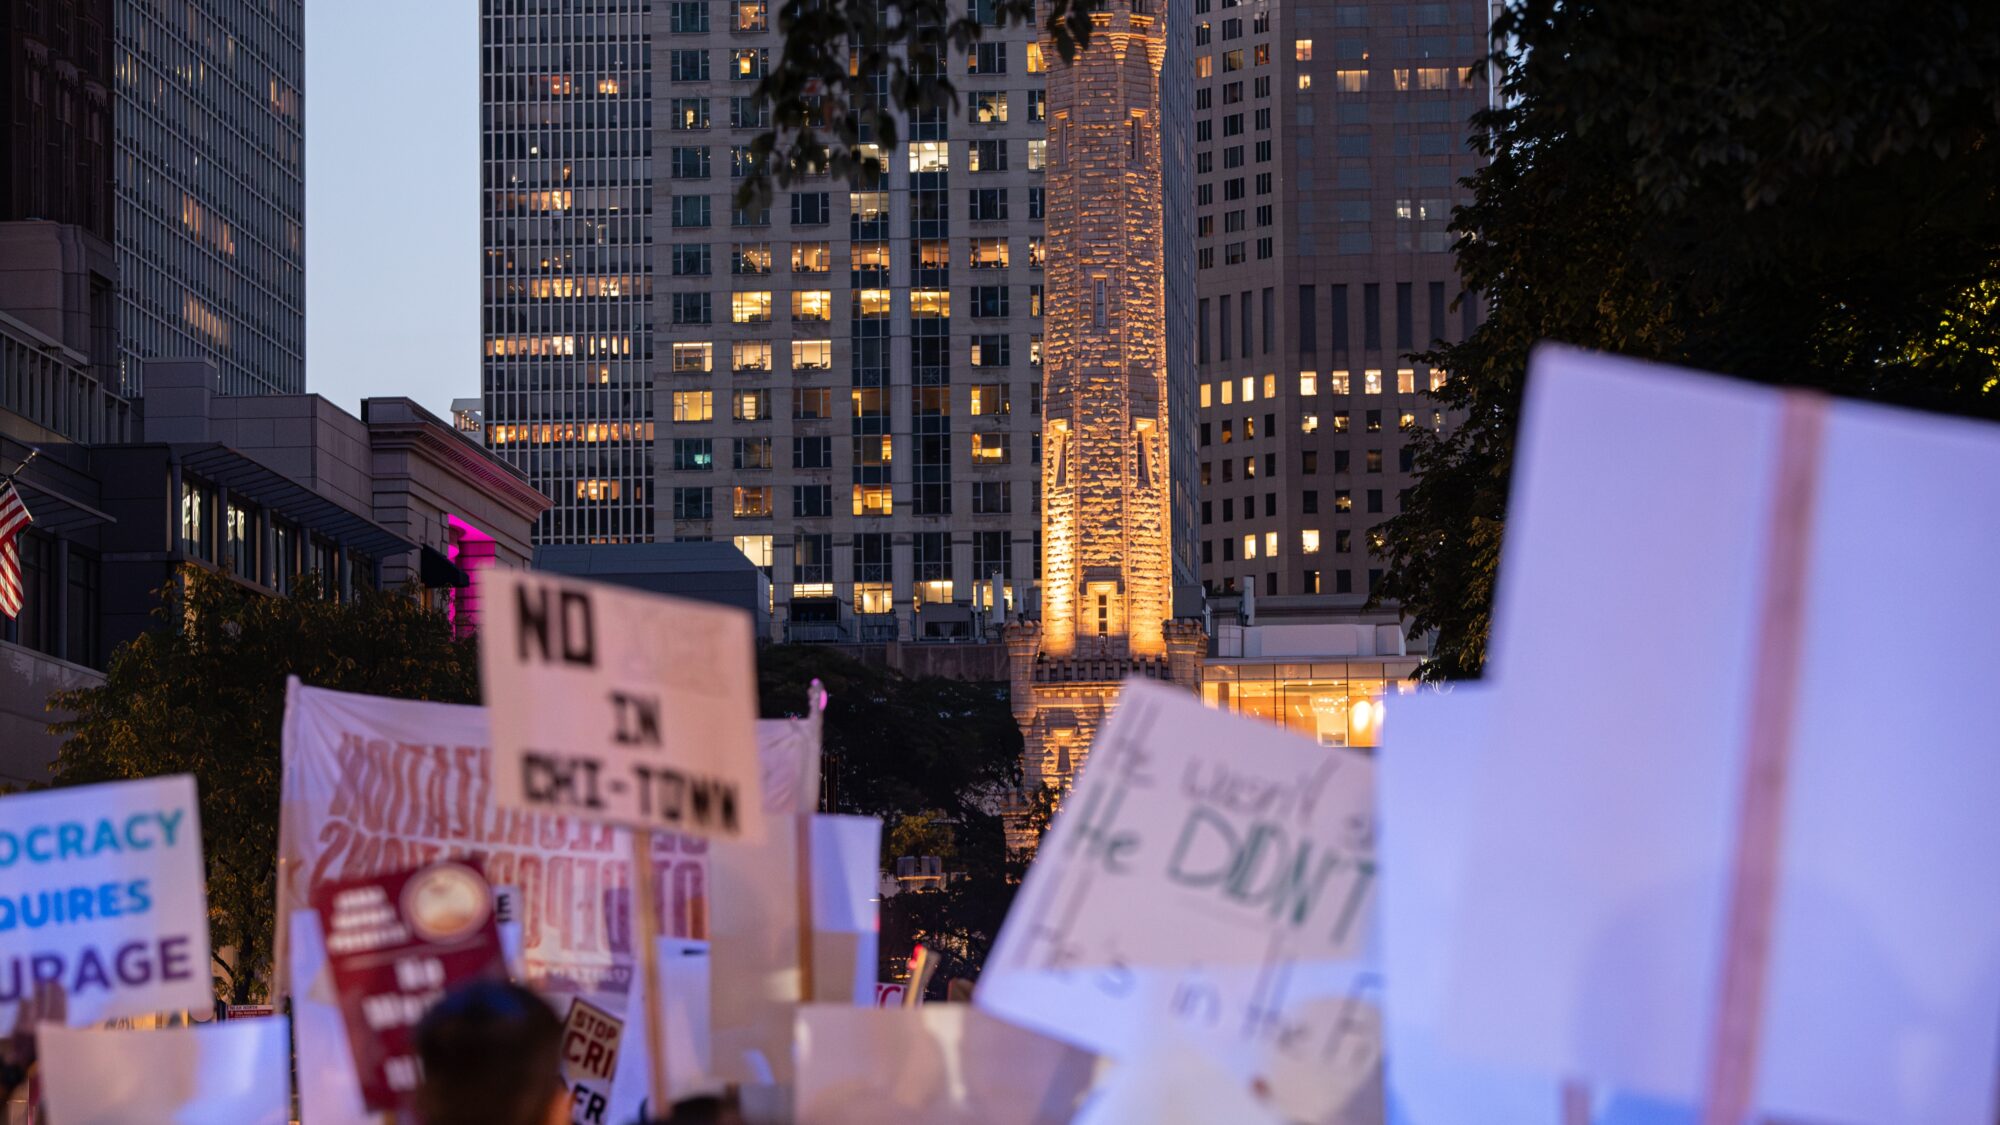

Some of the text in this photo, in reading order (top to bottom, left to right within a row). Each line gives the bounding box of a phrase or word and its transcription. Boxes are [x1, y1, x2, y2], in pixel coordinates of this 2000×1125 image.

[514, 582, 597, 668] NO
[609, 689, 664, 748] IN
[521, 752, 742, 835] CHI-TOWN
[0, 807, 184, 867] OCRACY
[1065, 780, 1143, 875] He
[0, 879, 152, 931] QUIRES
[574, 1009, 618, 1039] STOP
